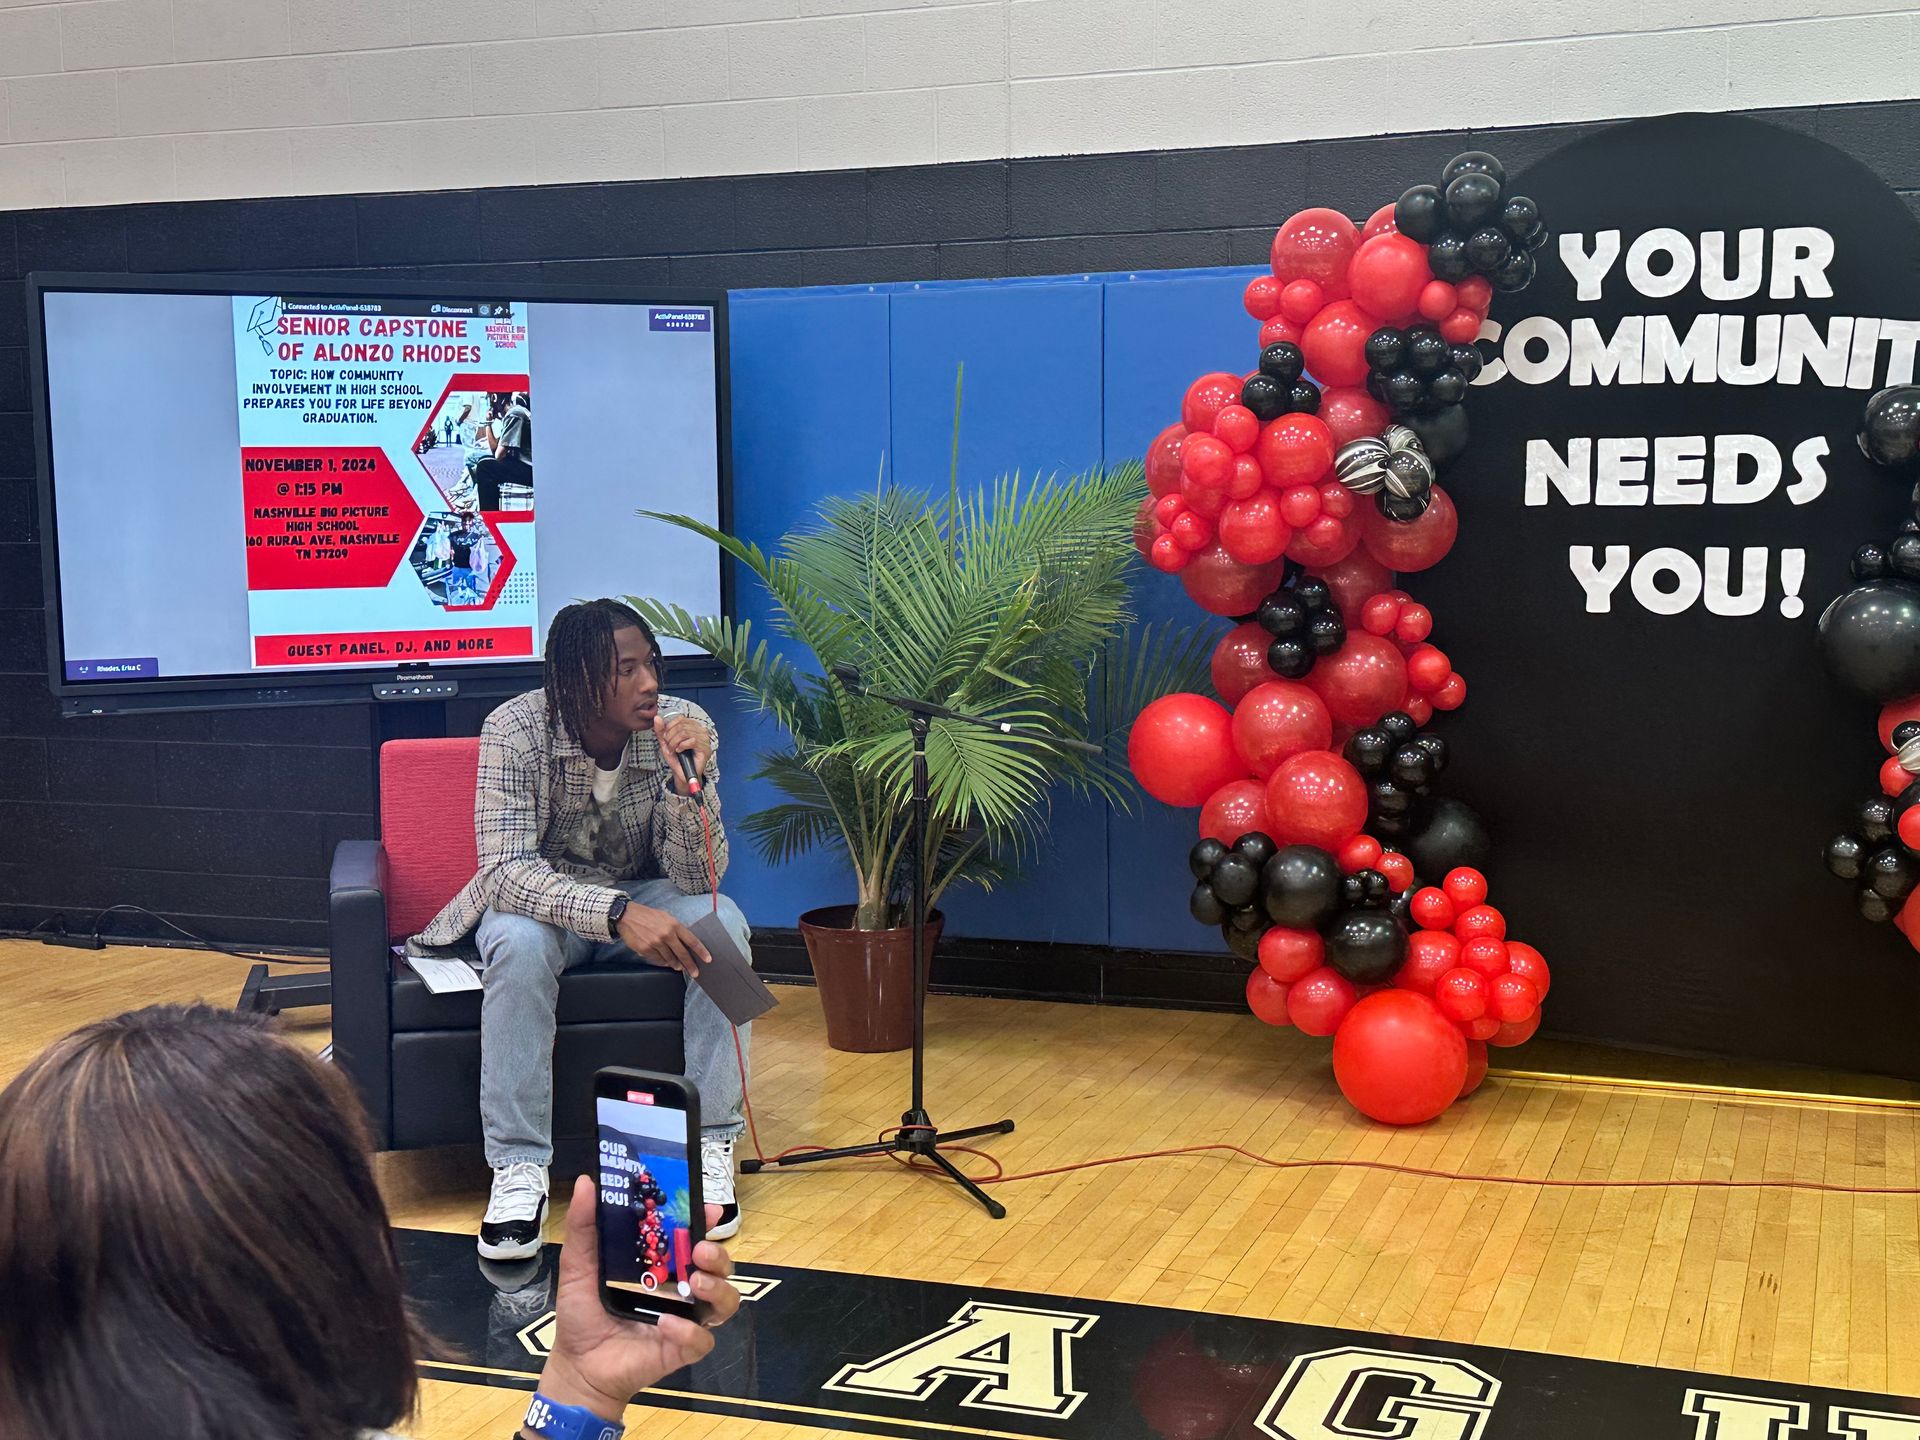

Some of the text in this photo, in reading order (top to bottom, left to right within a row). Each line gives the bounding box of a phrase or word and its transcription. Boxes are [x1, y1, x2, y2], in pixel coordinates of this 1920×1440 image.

[1558, 227, 1835, 301] YOUR
[277, 316, 467, 338] SENIOR CAPSTONE
[278, 342, 481, 363] OF ALONZO RHODES
[1468, 313, 1920, 390] COMMUNIT
[270, 369, 404, 381] TOPIC: HOW COMMUNITY
[252, 383, 423, 395] INVOLVEMENT IN HIGH SCHOOL
[243, 398, 432, 410] PREPARES YOU FOR LIFE BEYOND
[302, 412, 378, 423] GRADUATION.
[245, 458, 376, 473] NOVEMBER 1, 2024
[1524, 434, 1830, 506] NEEDS
[277, 483, 343, 496] @ 1:15 PM
[254, 506, 390, 519] NASHVILLE BIG PICTURE
[286, 520, 360, 532] HIGH SCHOOL
[267, 535, 306, 546] RURAL
[309, 535, 336, 546] AVE,
[339, 534, 400, 545] NASHVILLE
[295, 548, 349, 560] TN 37209
[1569, 544, 1806, 619] YOU!
[287, 638, 494, 657] GUEST PANEL, DJ, AND MORE
[599, 1140, 628, 1158] OUR
